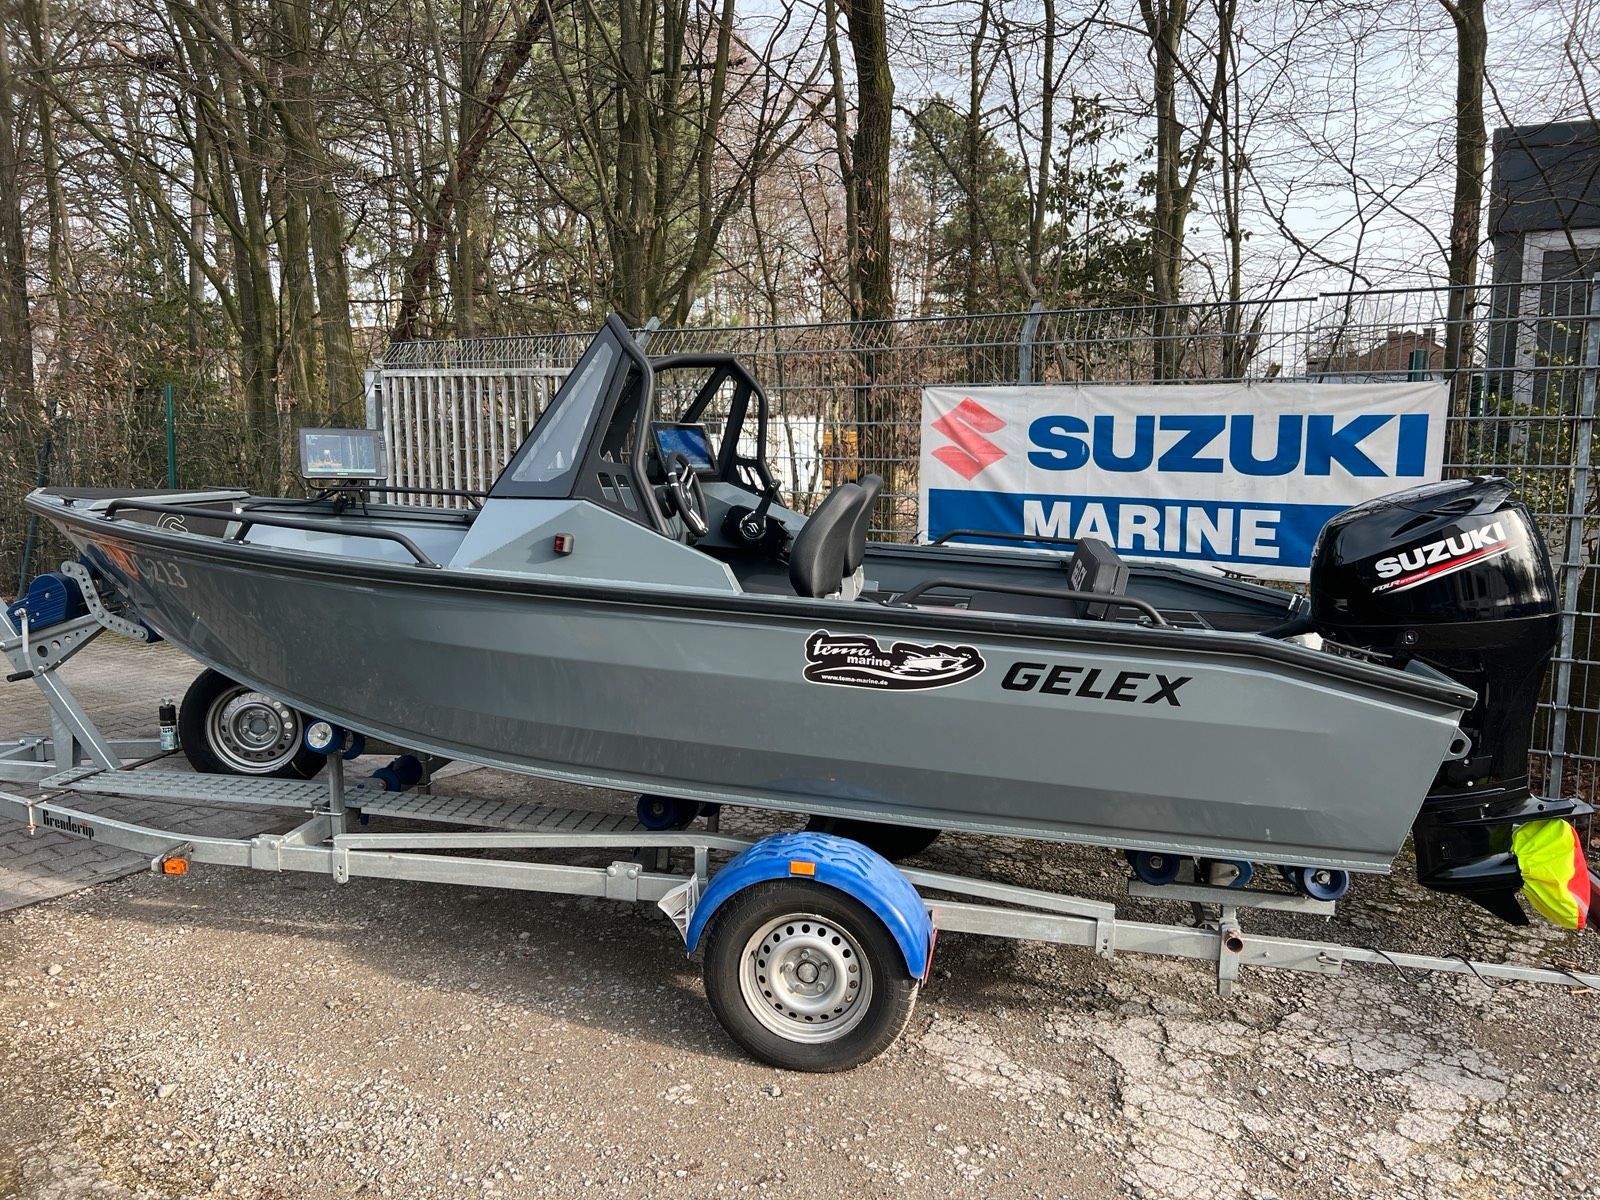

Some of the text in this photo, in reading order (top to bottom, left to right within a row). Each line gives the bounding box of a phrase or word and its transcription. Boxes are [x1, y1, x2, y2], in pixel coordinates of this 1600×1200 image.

[1027, 413, 1429, 478] SUZUKI
[1023, 500, 1281, 560] MARINE
[1375, 521, 1507, 578] SUZUKI
[813, 638, 873, 656] tema
[846, 655, 891, 667] marine
[821, 674, 889, 686] www.tema-marine.de
[1001, 661, 1193, 706] GELEX
[42, 809, 94, 840] Brenderup
